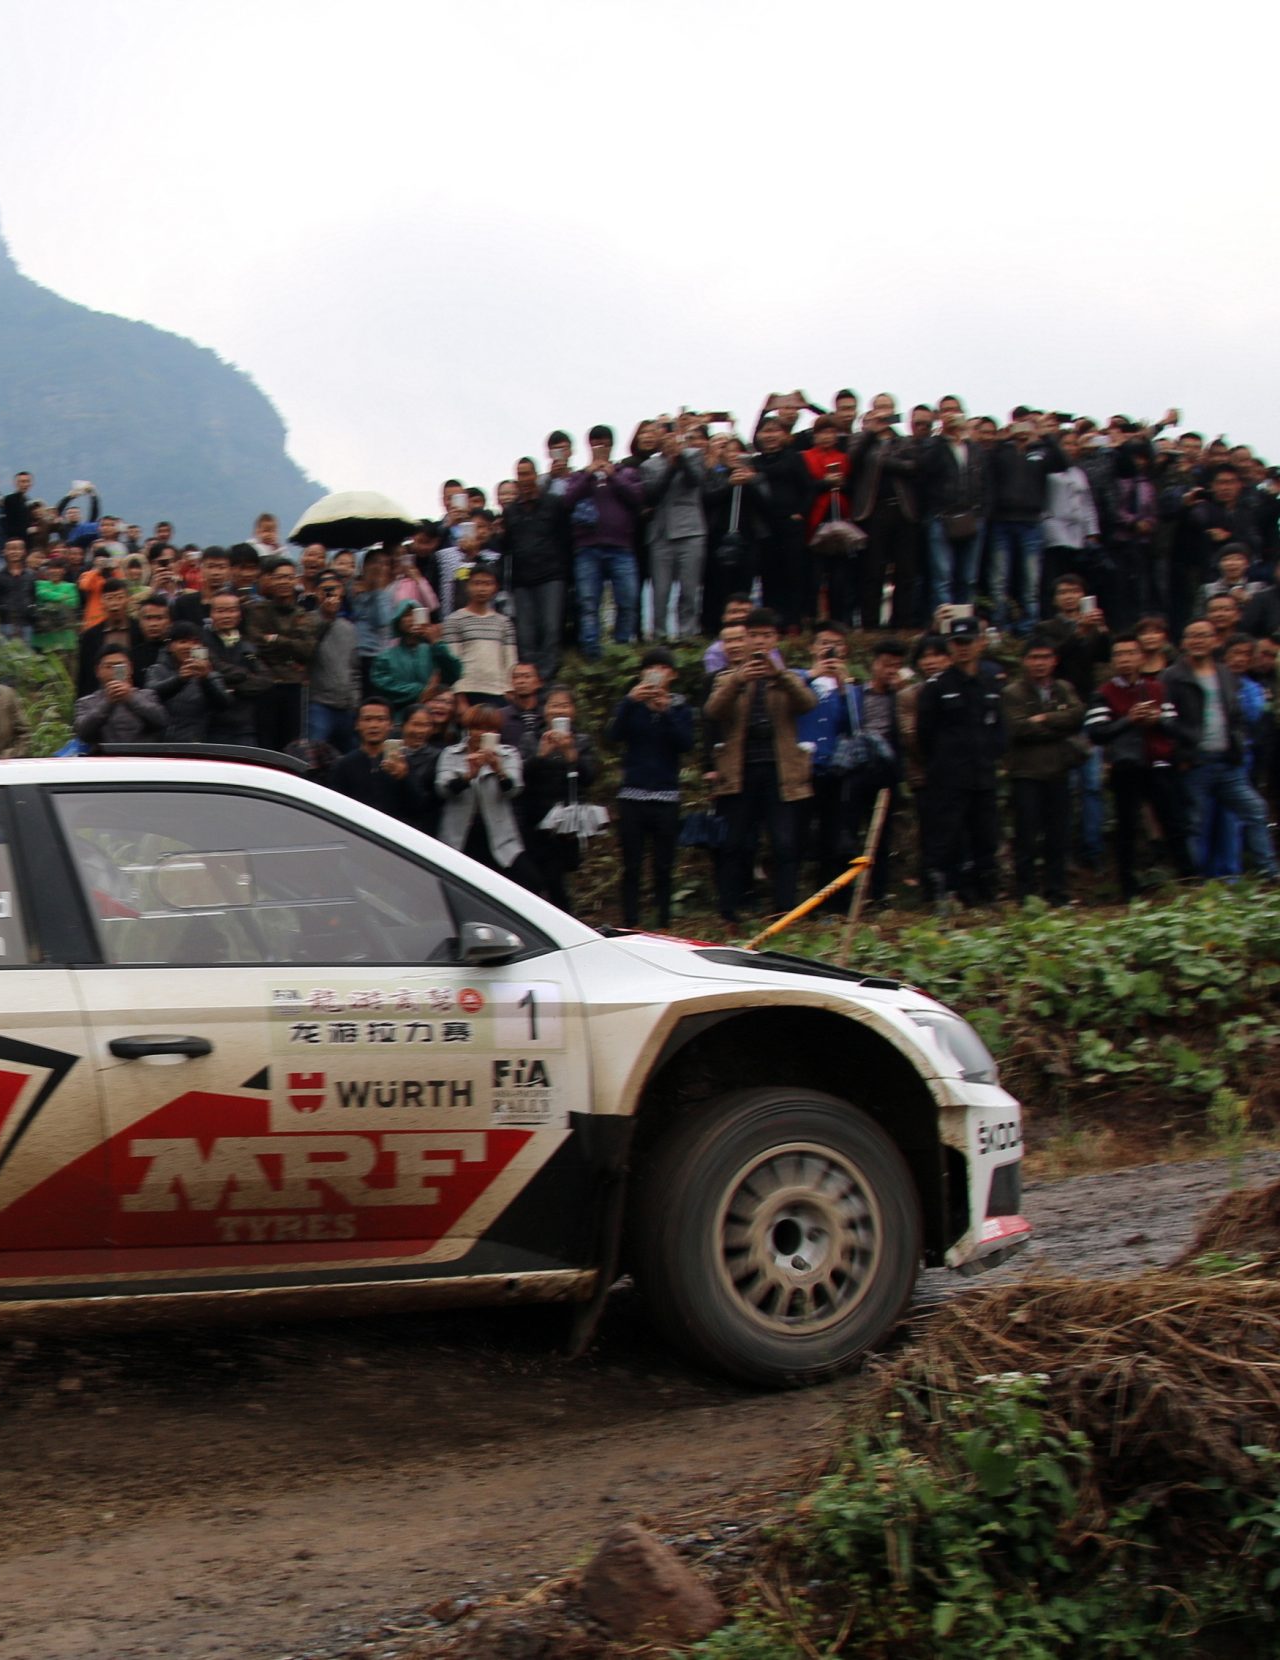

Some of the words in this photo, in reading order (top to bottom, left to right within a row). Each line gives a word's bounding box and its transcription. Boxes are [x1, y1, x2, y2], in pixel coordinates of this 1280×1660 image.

[290, 1021, 472, 1043] 龙游拉力赛
[519, 991, 537, 1040] 1
[121, 1133, 487, 1212] MRF
[216, 1214, 357, 1242] TYRES
